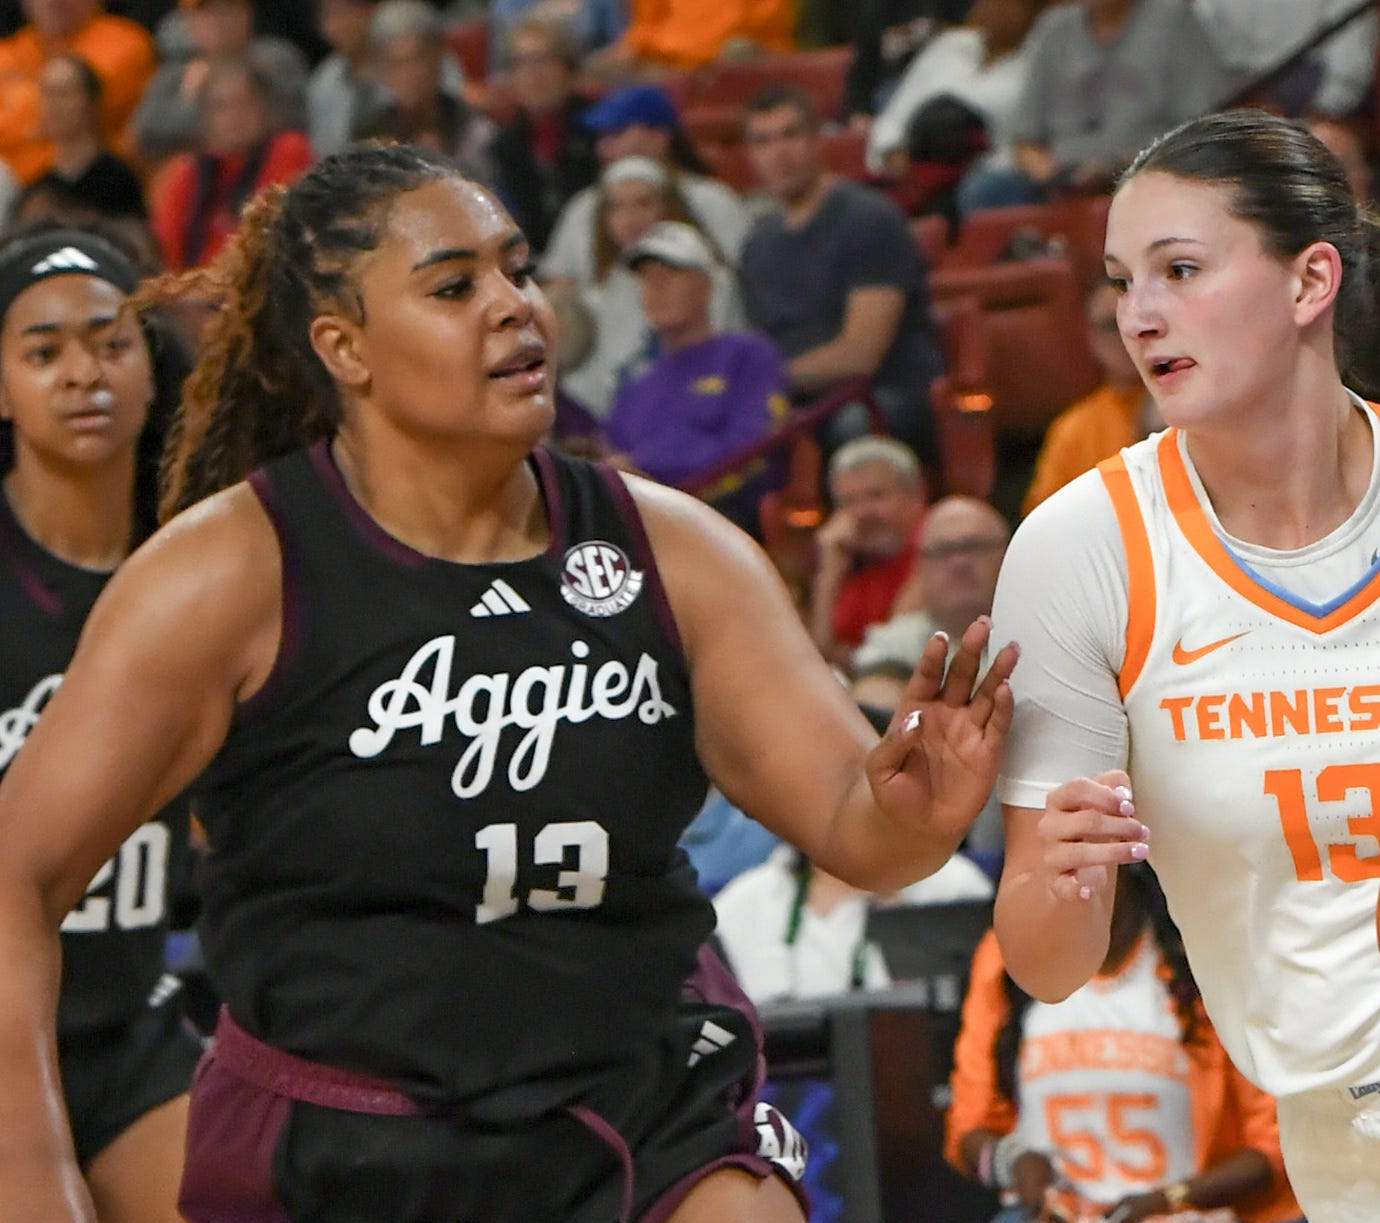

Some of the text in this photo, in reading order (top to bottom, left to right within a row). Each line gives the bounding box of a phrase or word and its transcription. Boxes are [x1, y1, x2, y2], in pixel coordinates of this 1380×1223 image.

[564, 544, 626, 600] SEC
[349, 635, 678, 799] Aggies
[475, 821, 610, 925] 13
[1044, 1092, 1168, 1183] 55
